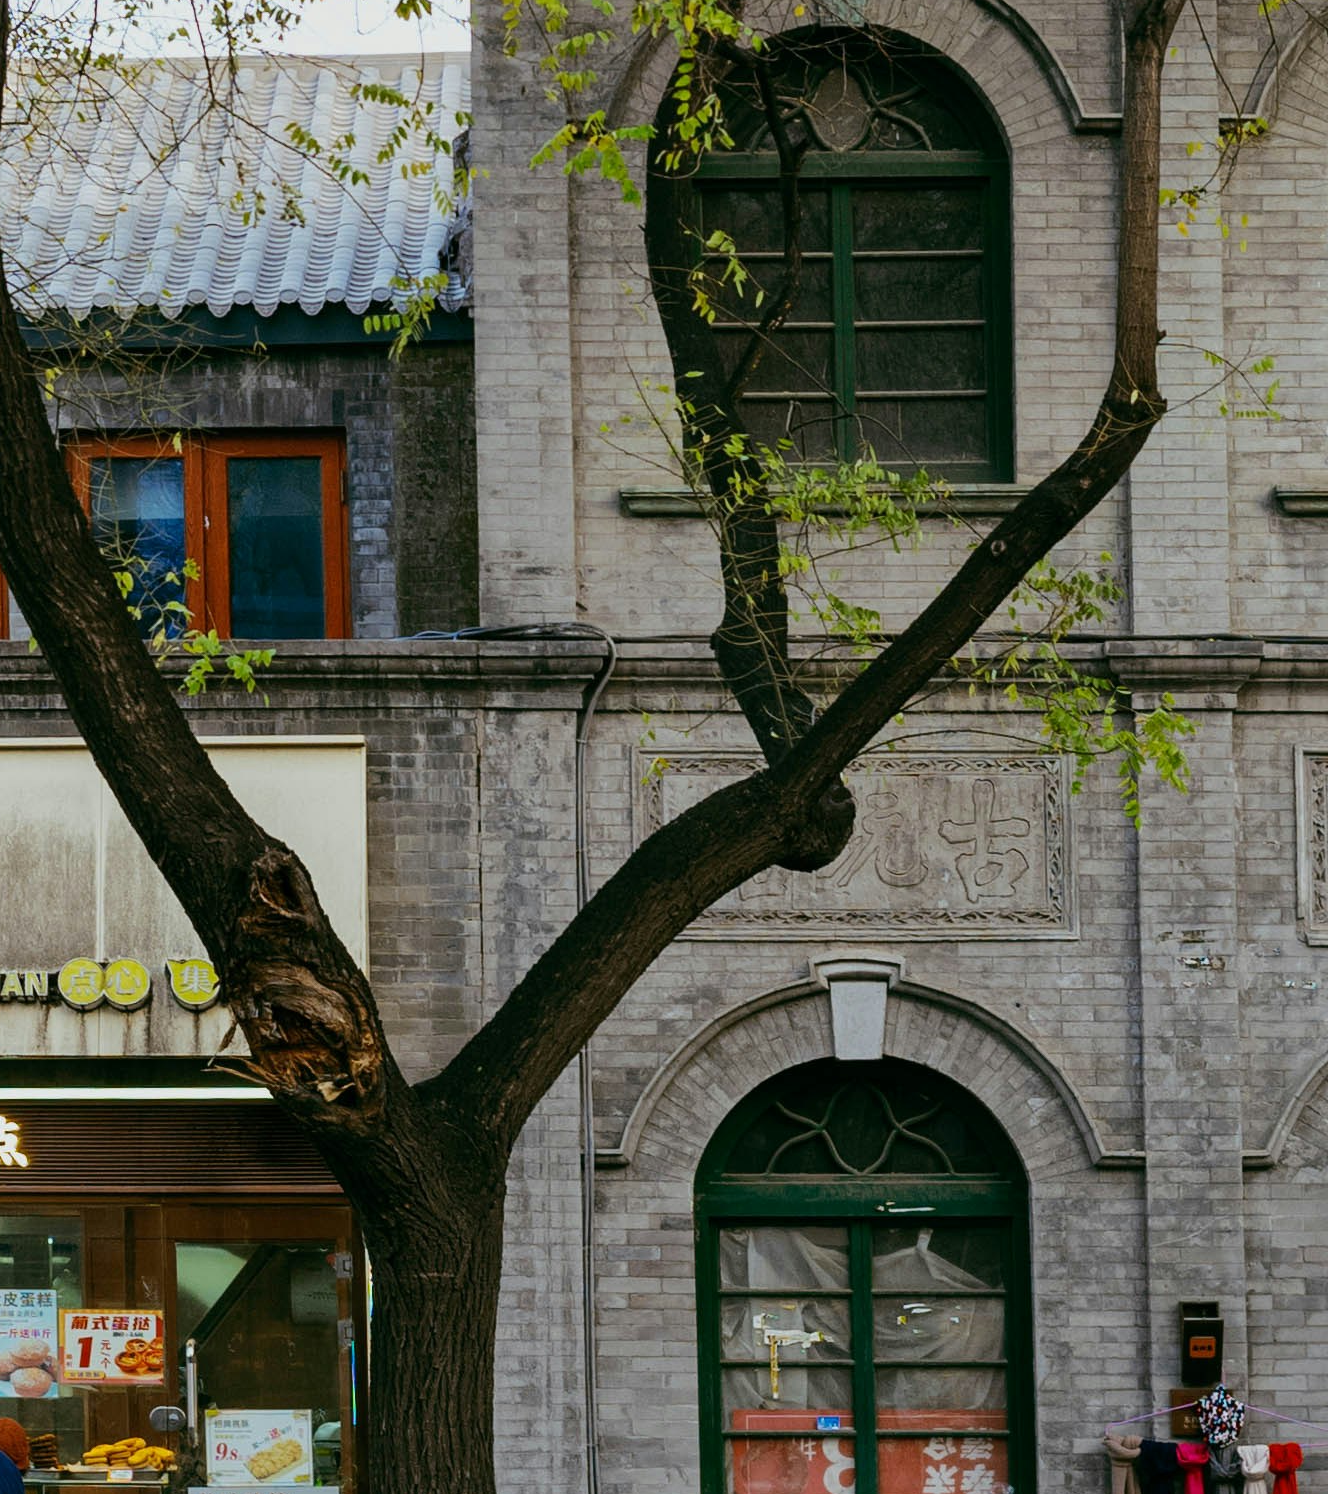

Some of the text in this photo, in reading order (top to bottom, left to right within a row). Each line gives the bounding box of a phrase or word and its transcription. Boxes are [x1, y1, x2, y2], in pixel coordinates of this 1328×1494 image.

[66, 968, 141, 996] 点心
[179, 965, 213, 993] 集
[71, 1316, 151, 1331] 葡式蛋挞
[77, 1336, 93, 1368] 1
[215, 1443, 239, 1461] 9.8
